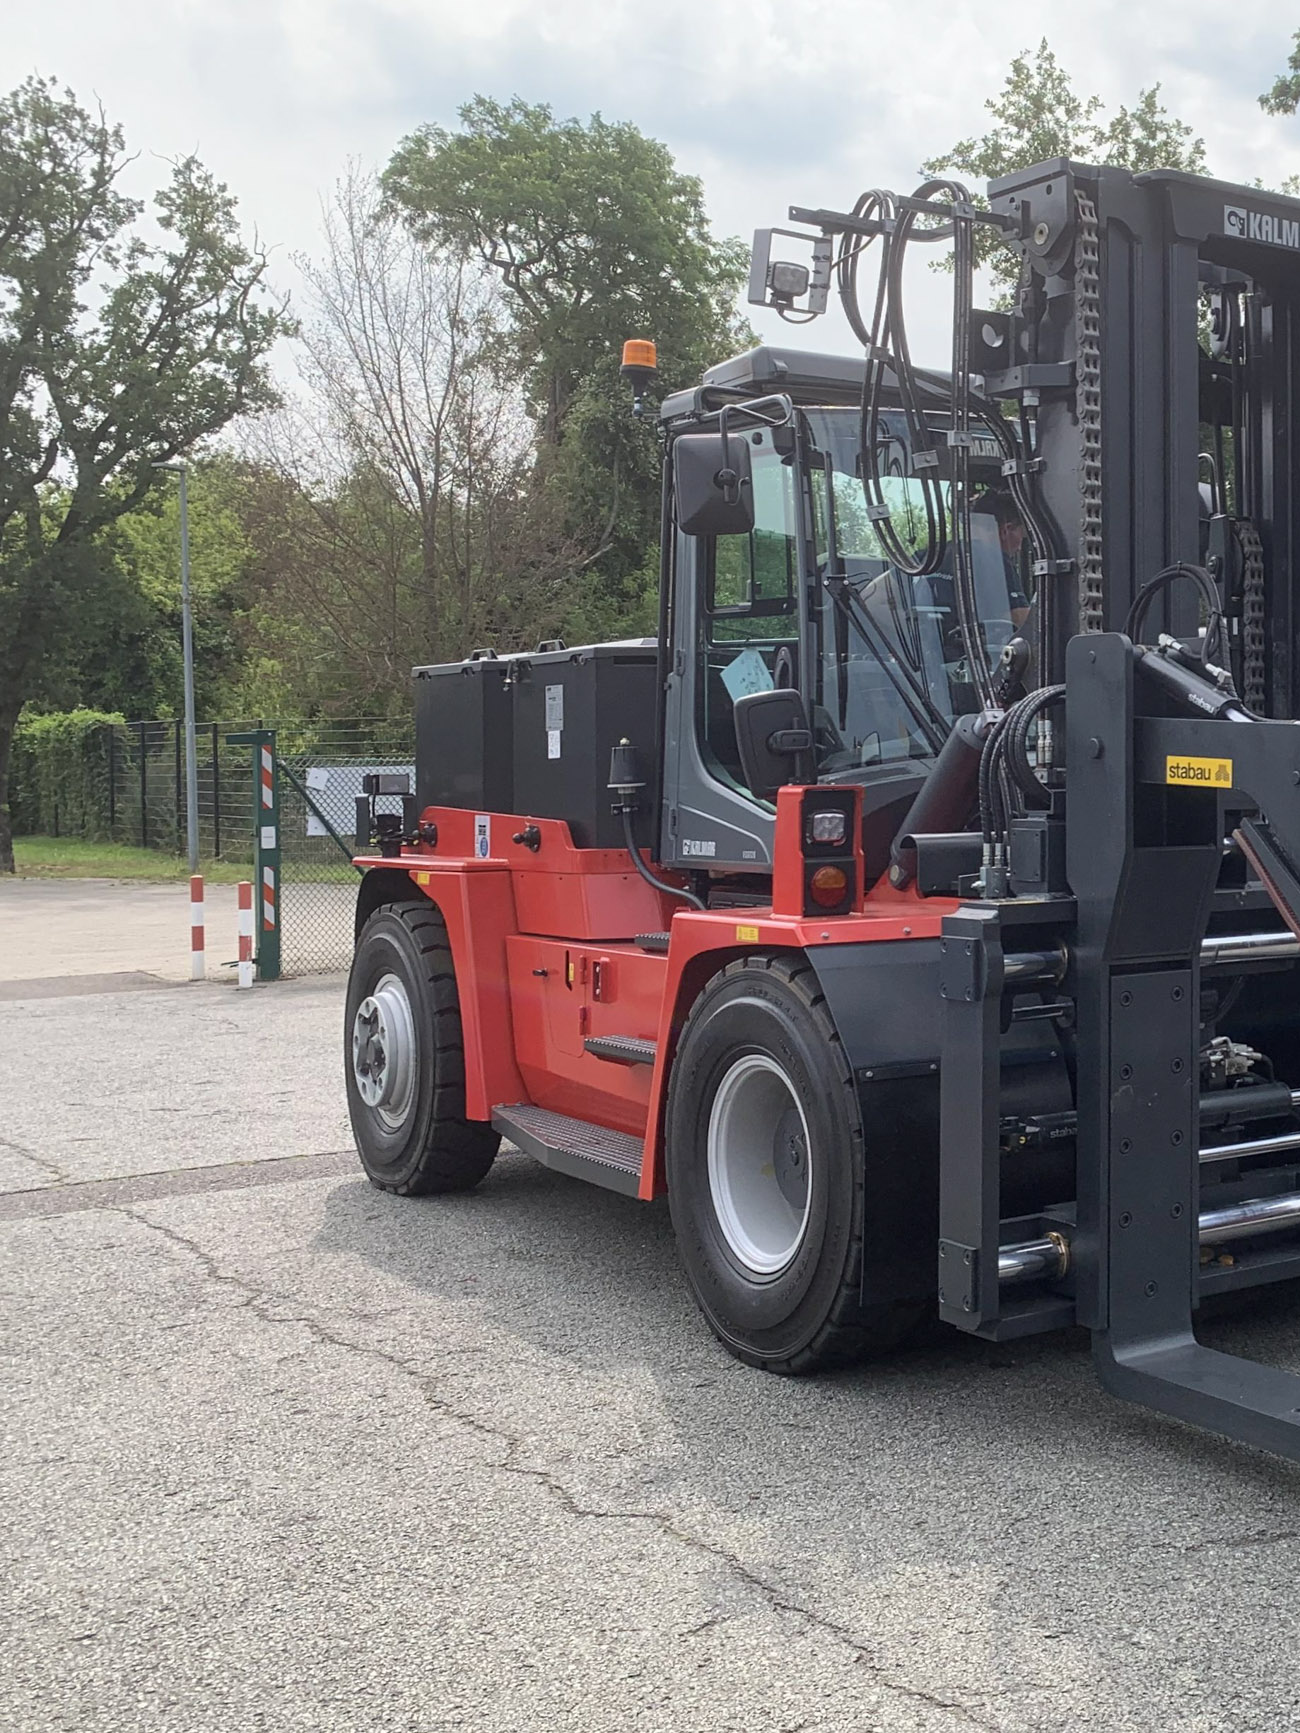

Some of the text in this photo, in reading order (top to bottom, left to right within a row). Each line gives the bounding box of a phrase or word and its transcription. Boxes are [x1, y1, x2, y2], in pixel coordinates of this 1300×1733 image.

[1188, 693, 1215, 713] stabau
[1169, 762, 1211, 780] stabau
[1050, 1127, 1078, 1138] staba
